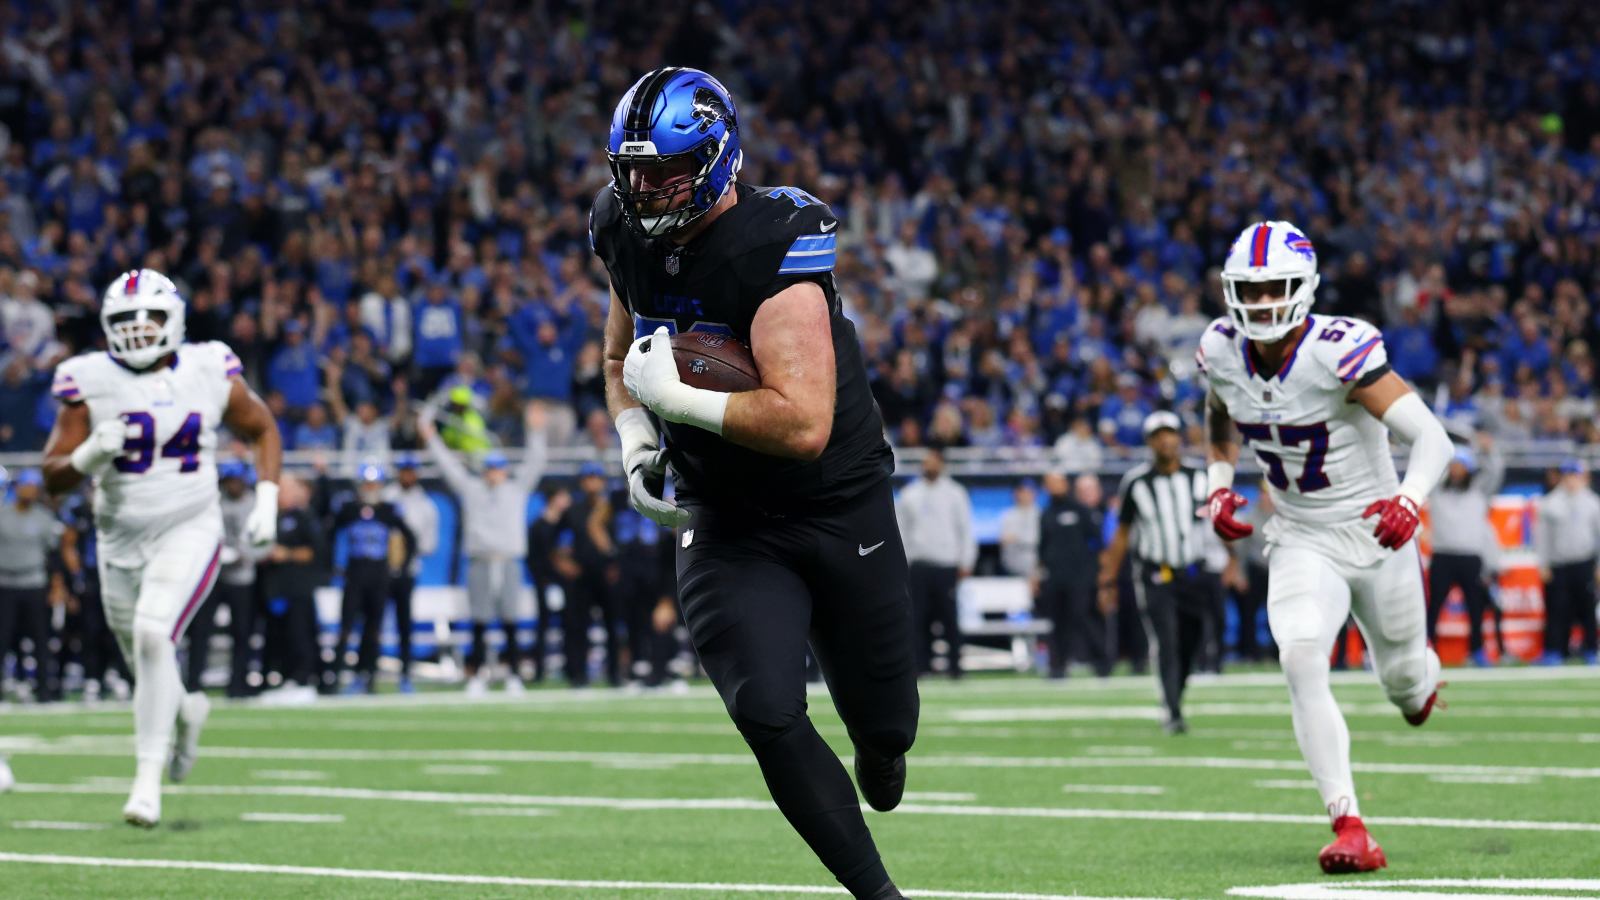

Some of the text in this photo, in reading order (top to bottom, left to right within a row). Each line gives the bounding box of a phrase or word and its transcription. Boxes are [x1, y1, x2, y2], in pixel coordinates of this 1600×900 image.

[625, 145, 645, 153] DETROIT
[700, 333, 721, 346] NFL
[1317, 316, 1356, 343] 57
[692, 365, 704, 374] 047
[112, 411, 203, 474] 94
[1234, 421, 1331, 493] 57
